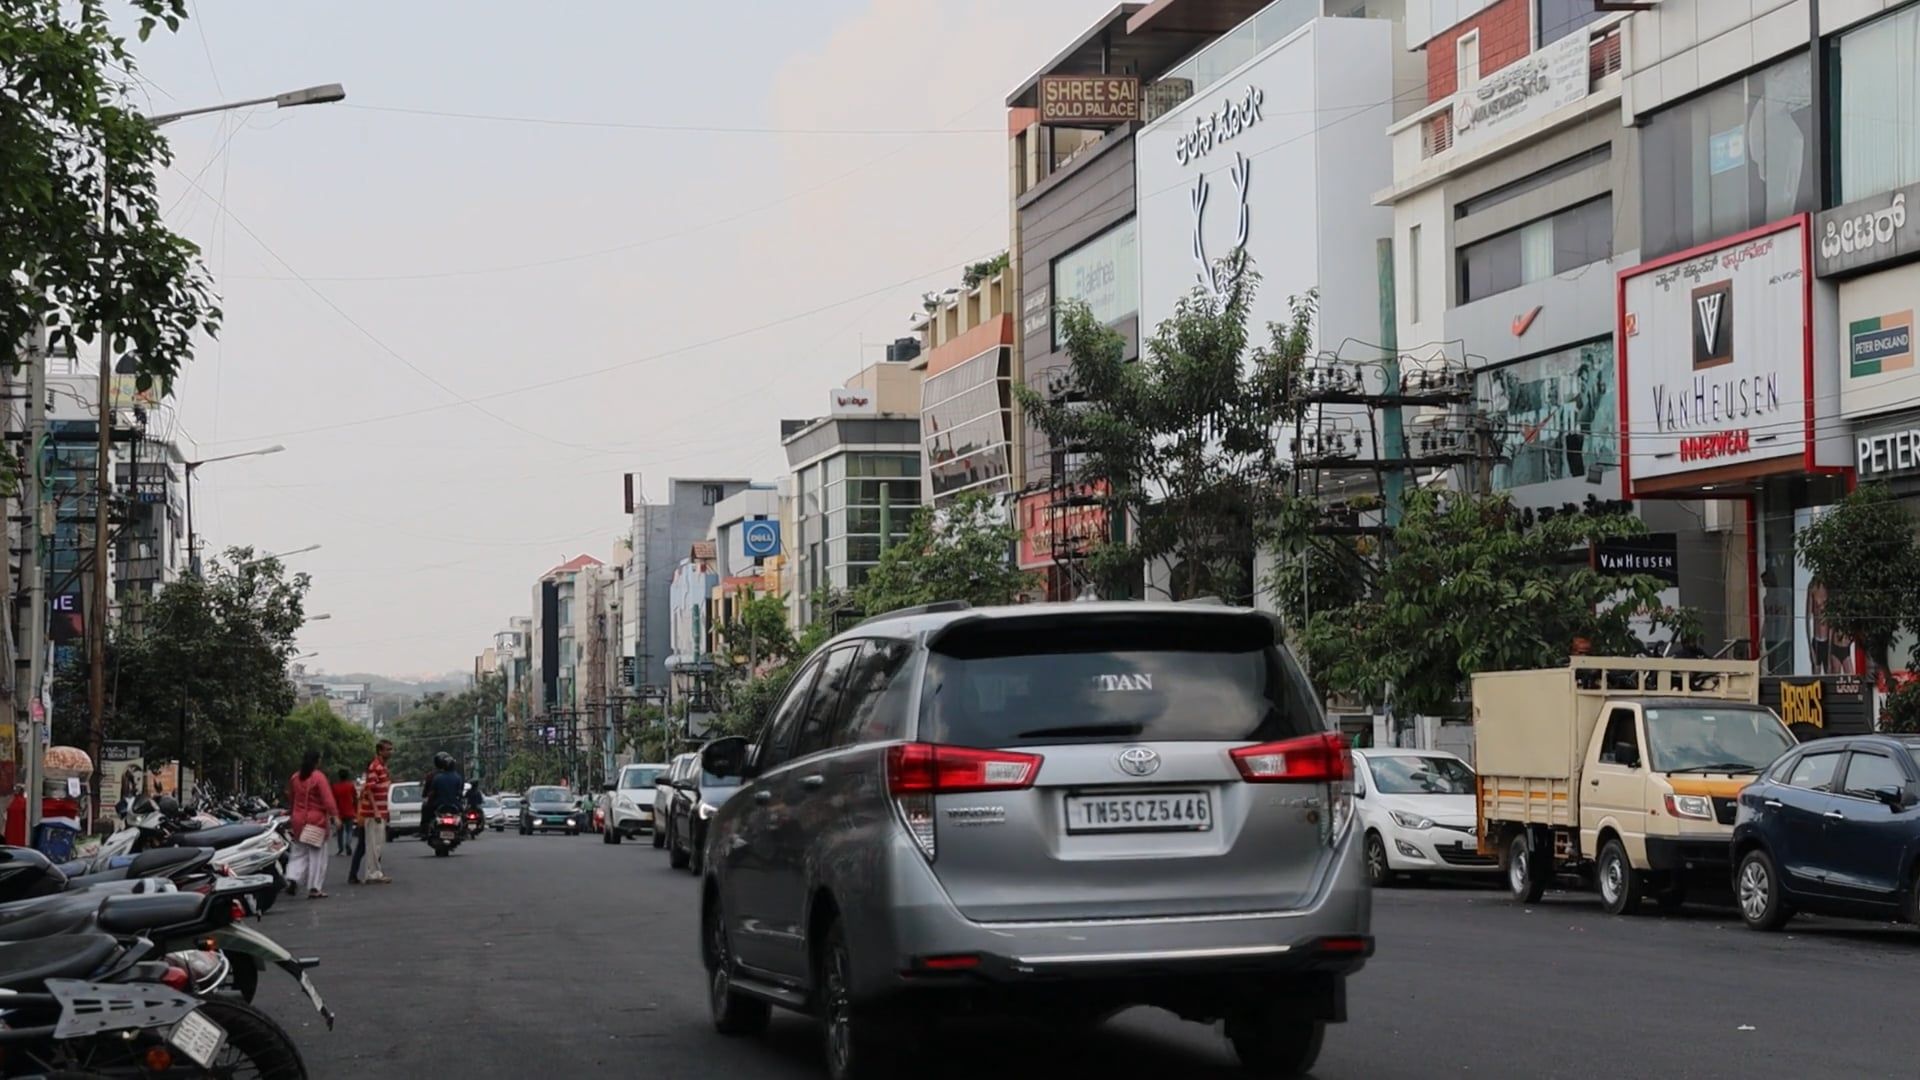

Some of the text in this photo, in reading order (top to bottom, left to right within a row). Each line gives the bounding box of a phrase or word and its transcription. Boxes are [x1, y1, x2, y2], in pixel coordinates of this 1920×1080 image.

[1046, 81, 1105, 101] SHREE
[1108, 80, 1134, 100] SAI
[1045, 102, 1136, 116] GOLD PALACE
[1856, 334, 1909, 354] PETER ENGLAND
[1680, 429, 1751, 463] INNERWEAR
[1858, 429, 1920, 475] PETER
[750, 533, 773, 543] DELL
[1780, 680, 1823, 729] BASICS
[1083, 799, 1207, 824] TN55CZ5446
